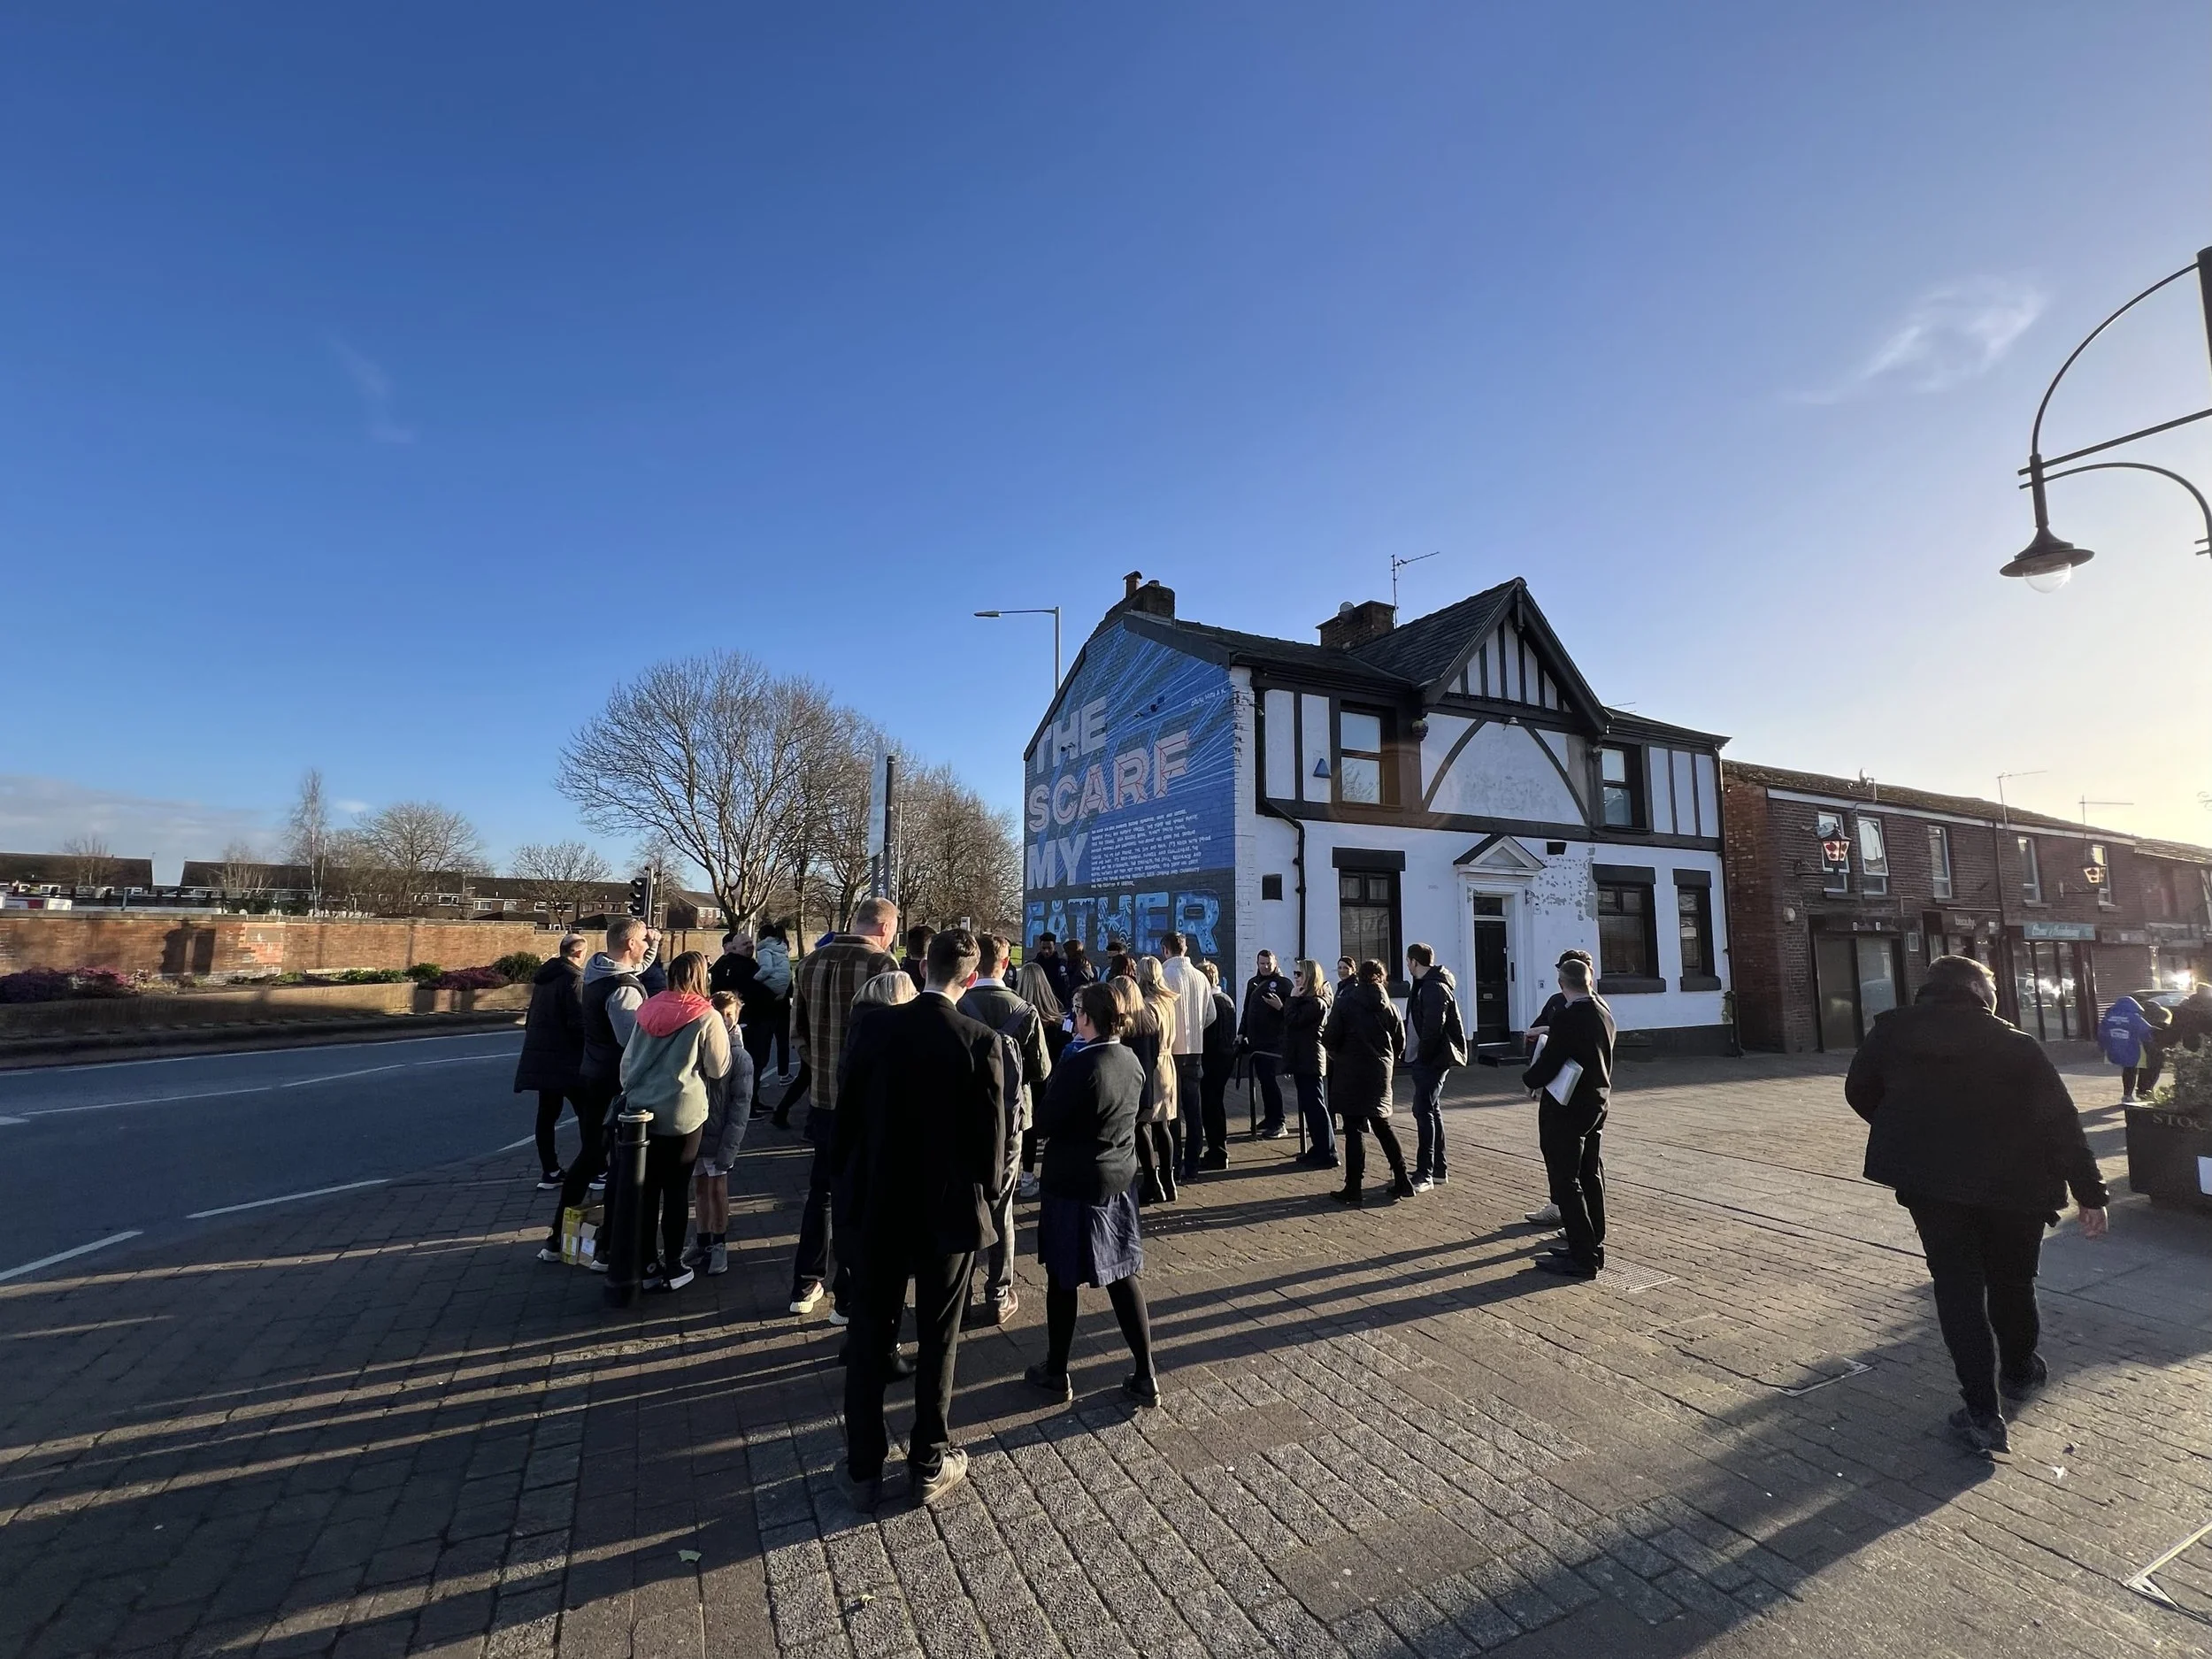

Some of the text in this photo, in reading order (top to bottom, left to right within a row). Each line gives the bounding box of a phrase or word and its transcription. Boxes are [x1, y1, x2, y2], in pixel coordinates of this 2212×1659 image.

[1036, 695, 1106, 774] THE
[1028, 729, 1189, 833] SCARF
[1026, 833, 1088, 890] MY
[1025, 889, 1220, 956] FATHER
